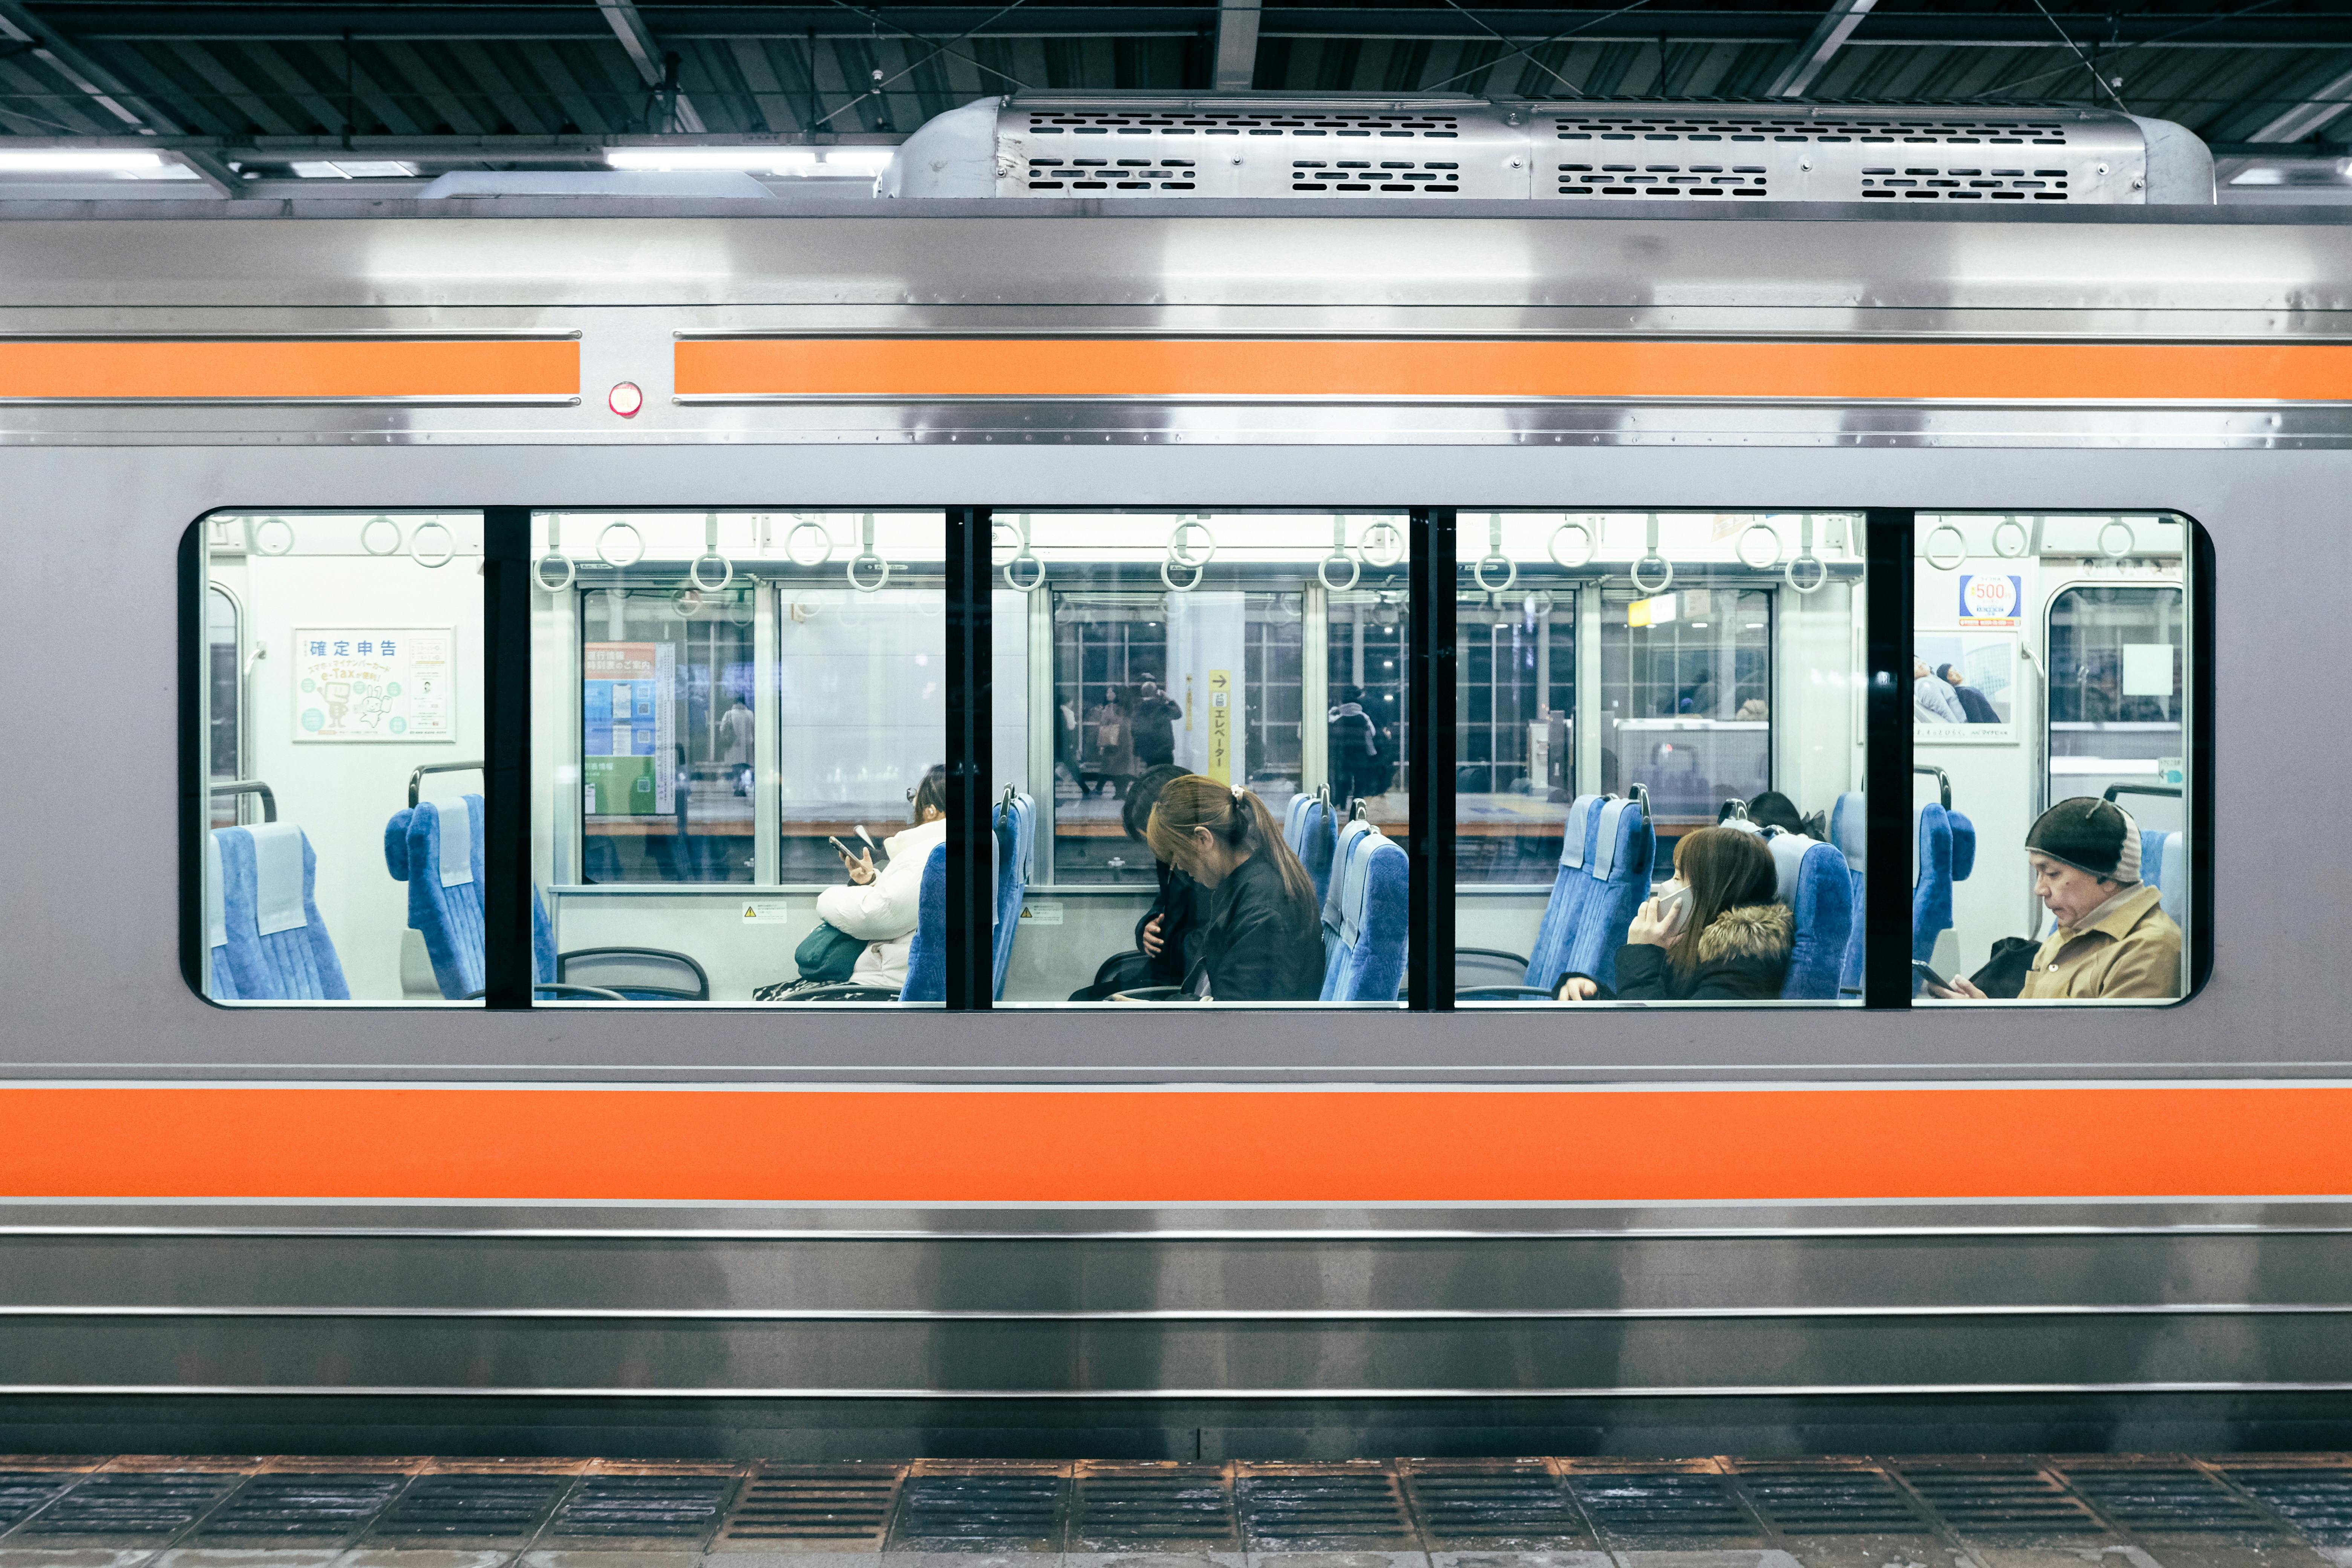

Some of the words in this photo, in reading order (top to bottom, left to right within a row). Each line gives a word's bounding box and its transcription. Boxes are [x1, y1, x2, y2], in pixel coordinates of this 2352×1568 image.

[310, 640, 396, 656] 確定申告
[1215, 710, 1225, 767] エレベーター
